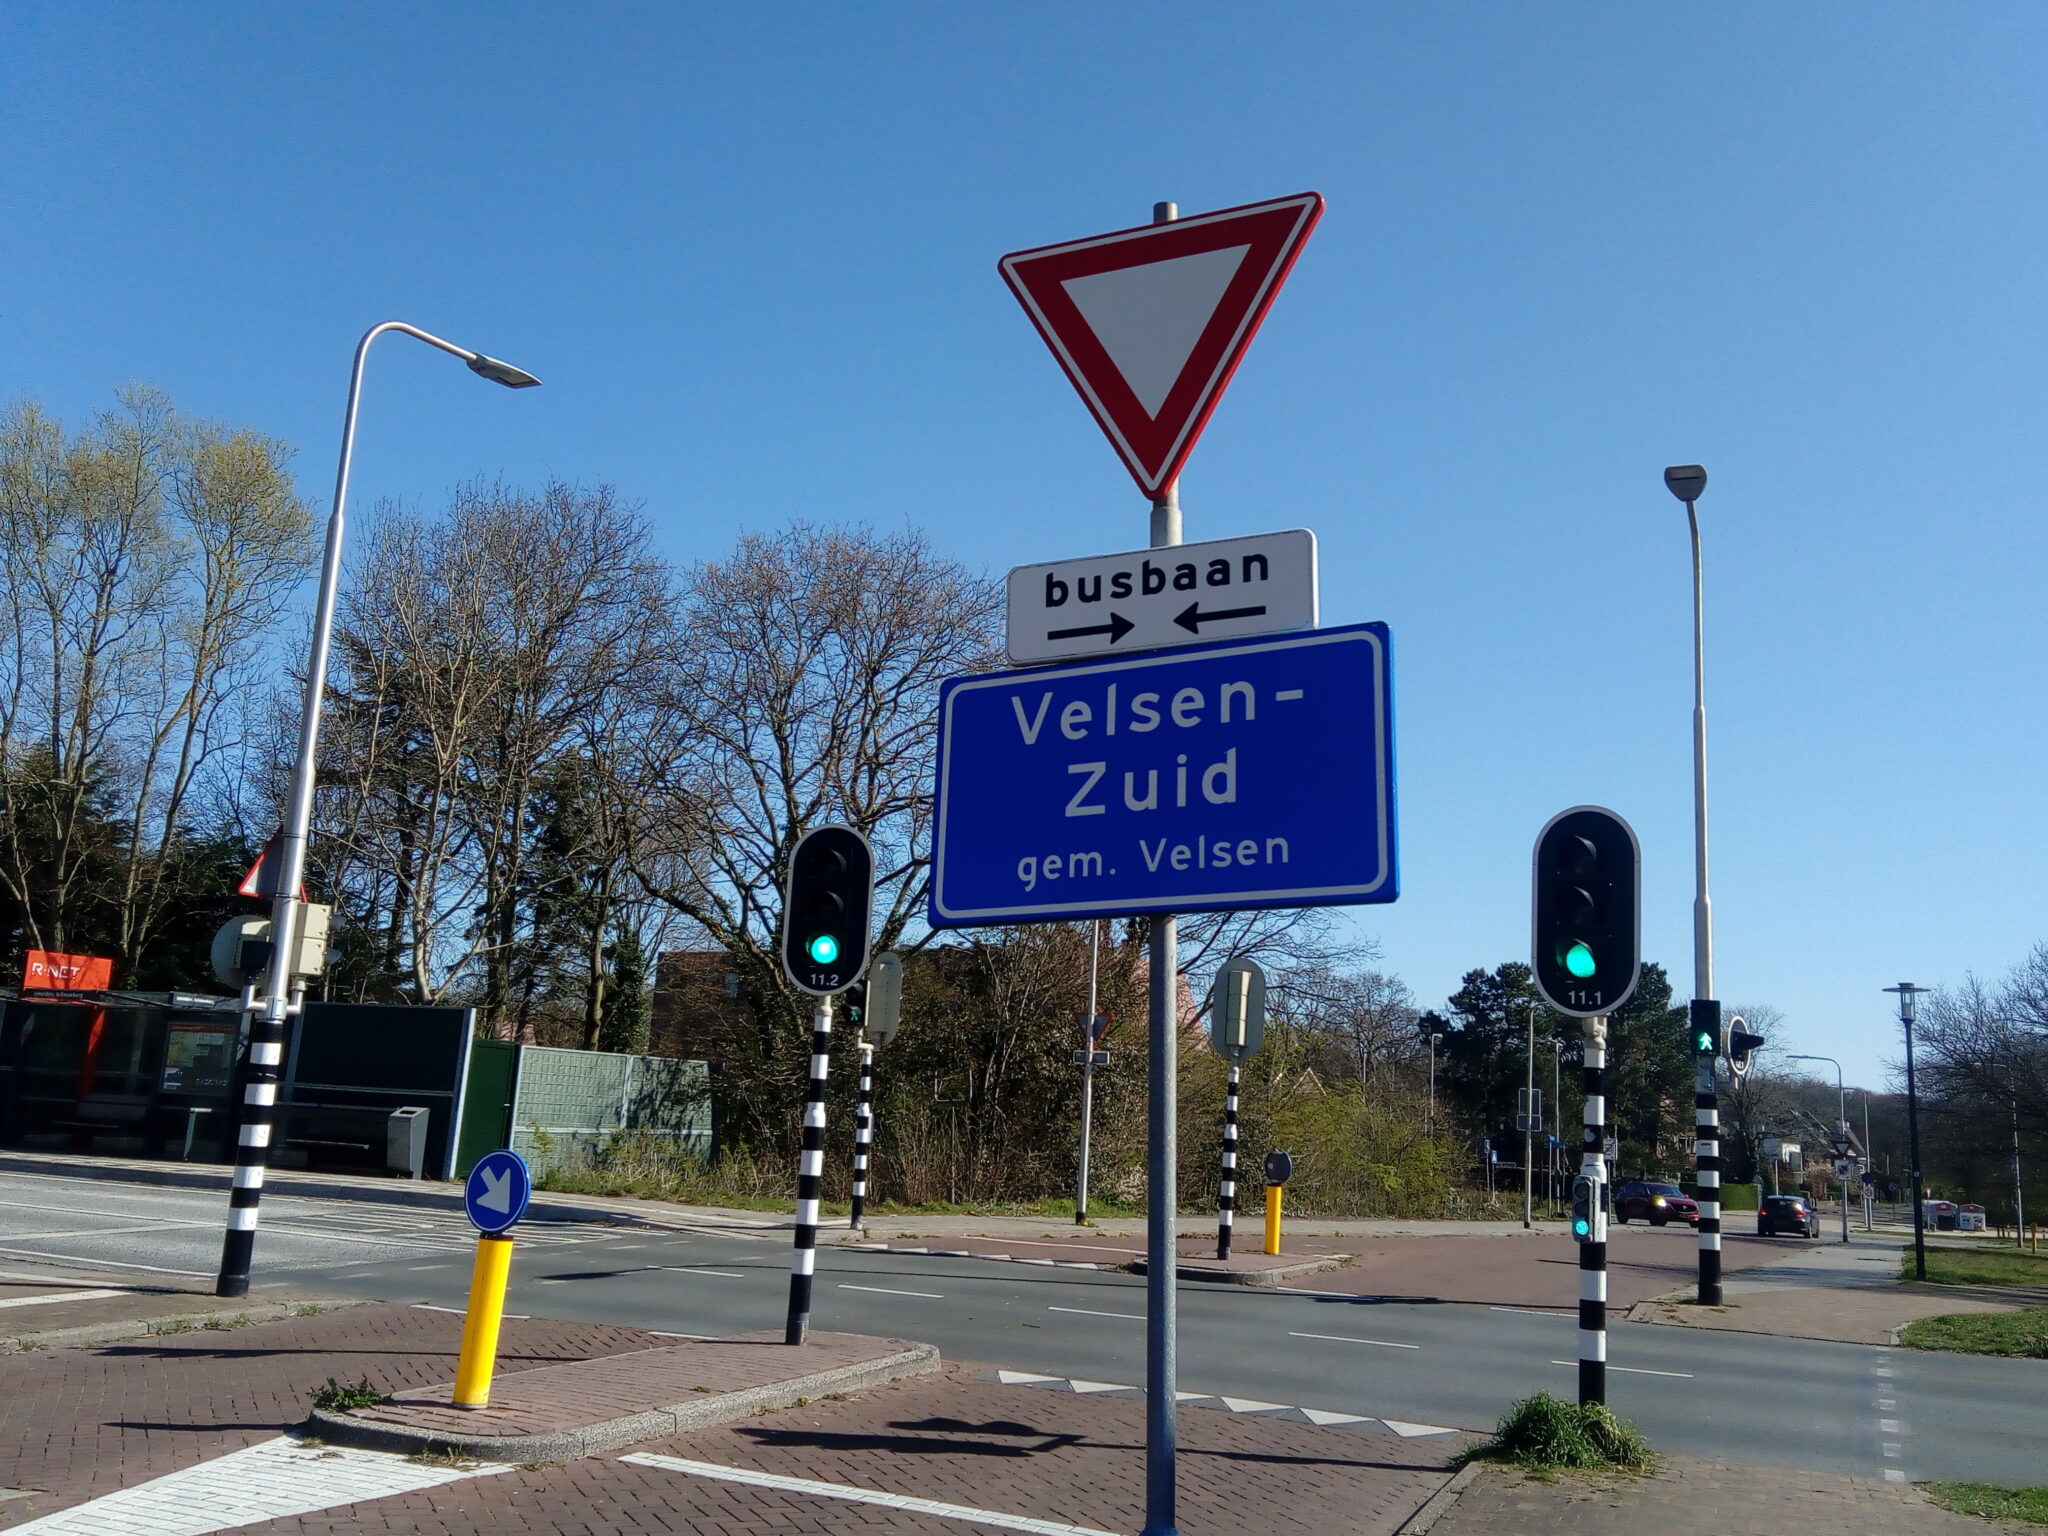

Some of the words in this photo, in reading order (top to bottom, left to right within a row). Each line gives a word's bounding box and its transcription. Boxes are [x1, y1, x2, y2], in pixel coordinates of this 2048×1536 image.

[1045, 552, 1269, 608] busbaan
[1011, 680, 1304, 745] Velsen-
[1065, 747, 1237, 817] Zuid
[1017, 850, 1117, 892] gem.
[1139, 834, 1290, 872] Velsen
[810, 973, 839, 986] 11.2
[1568, 990, 1602, 1005] 11.1
